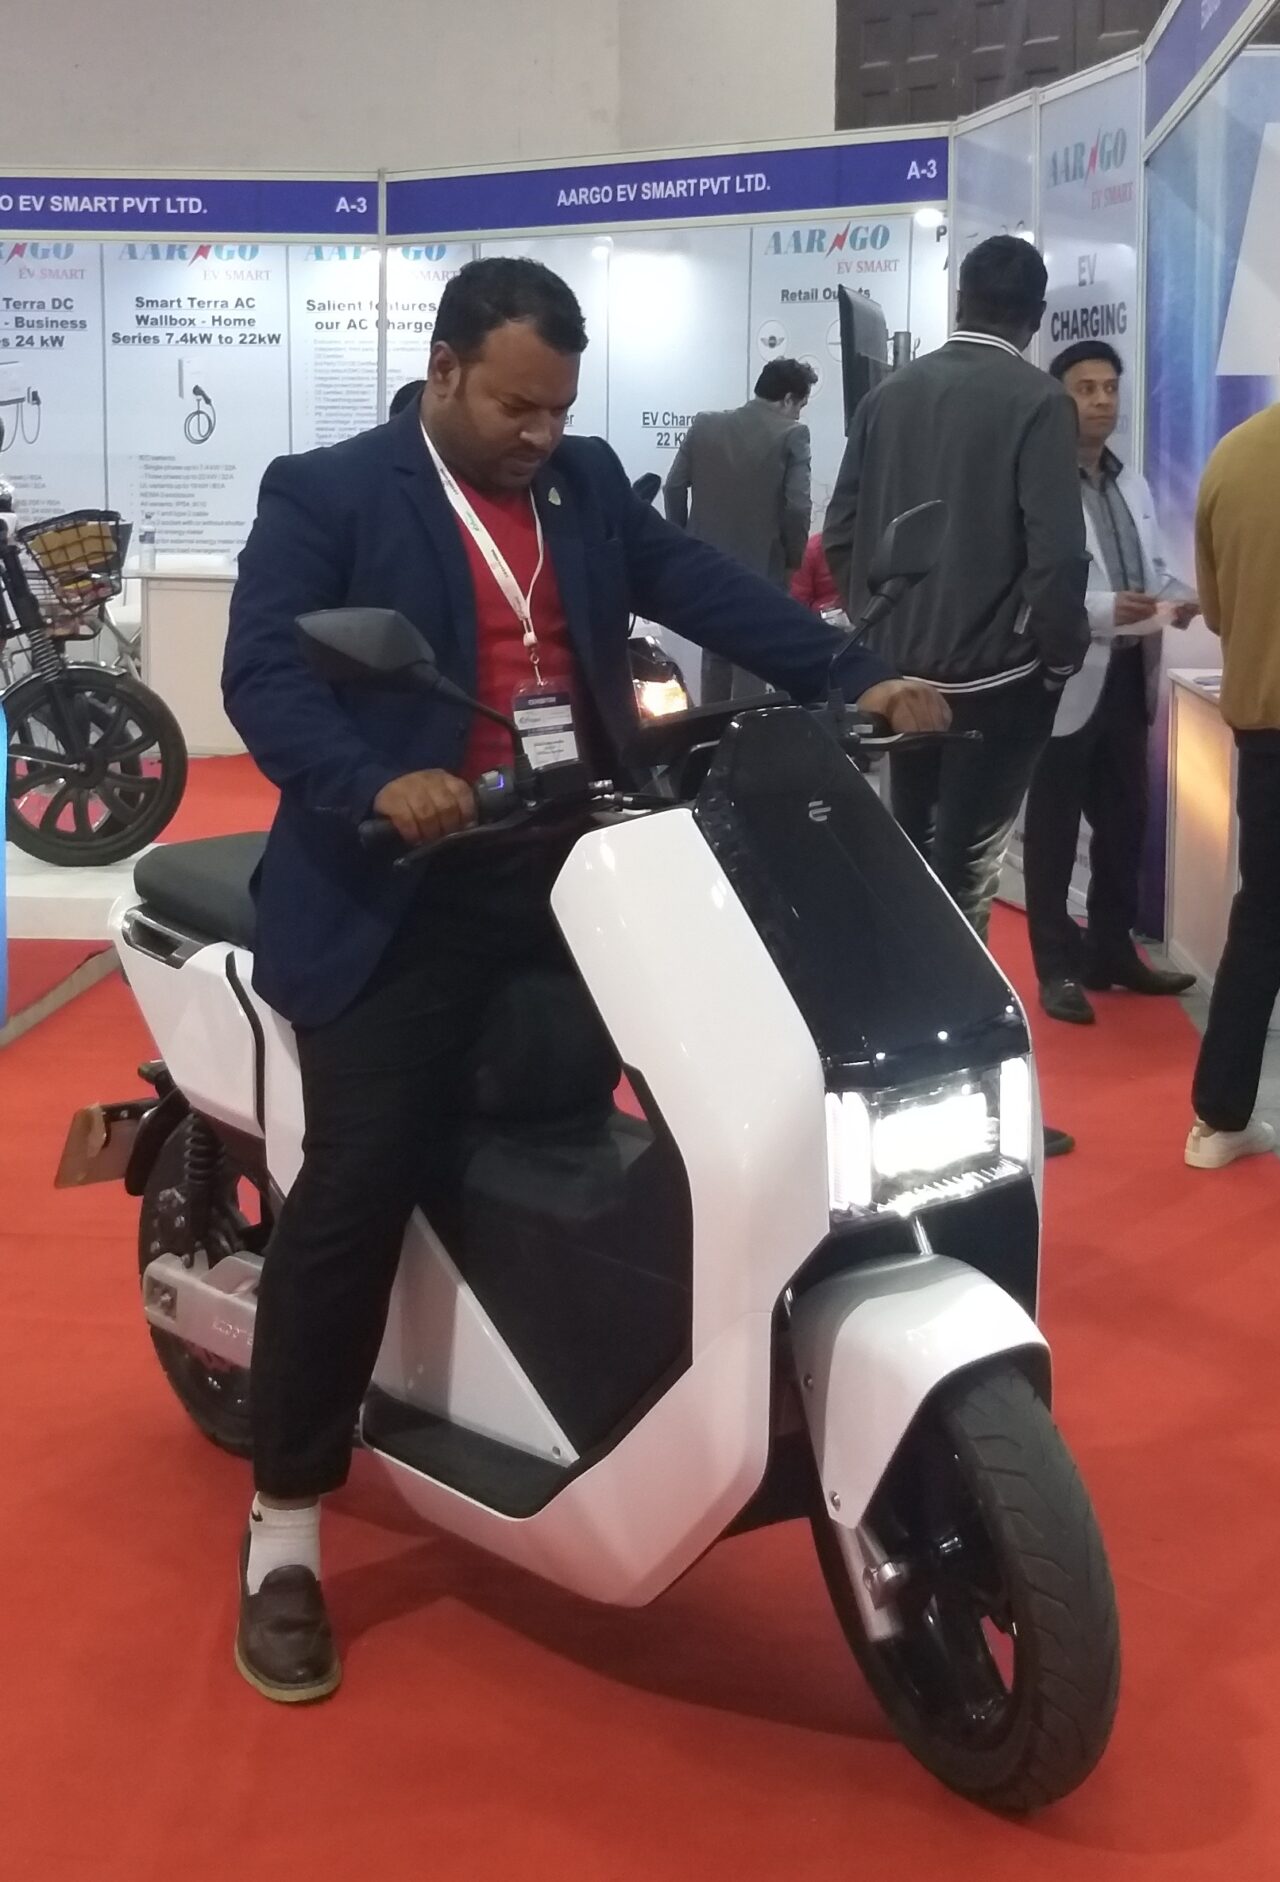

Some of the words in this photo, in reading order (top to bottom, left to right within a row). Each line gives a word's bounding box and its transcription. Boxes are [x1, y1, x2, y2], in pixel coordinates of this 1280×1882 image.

[907, 160, 938, 180] A-3
[557, 185, 613, 206] AARGO
[616, 183, 638, 202] EV
[641, 179, 697, 200] SMART
[699, 176, 731, 196] PVT
[735, 173, 771, 193] LTD.
[19, 195, 45, 211] EV
[50, 196, 119, 212] SMART
[123, 198, 161, 213] PVT
[166, 198, 208, 214] LTD.
[335, 197, 368, 213] A-3
[837, 261, 854, 275] EV
[856, 259, 900, 274] SMART
[1078, 252, 1098, 287] EV
[18, 269, 35, 280] EV
[39, 269, 87, 280] SMART
[225, 270, 272, 281] SMART
[781, 287, 818, 301] Retail
[822, 286, 871, 301] Outs
[2, 298, 46, 310] Terra
[51, 298, 74, 310] DC
[135, 296, 182, 309] Smart
[187, 297, 229, 309] Terra
[234, 297, 256, 309] AC
[306, 299, 362, 312] Salient
[369, 300, 437, 312] ftures
[14, 316, 88, 329] Business
[135, 314, 196, 327] Wallbox
[211, 315, 256, 327] Home
[315, 320, 341, 331] our
[347, 318, 368, 331] AC
[1050, 301, 1128, 342] CHARGING
[15, 335, 35, 347] 24
[40, 335, 65, 348] kW
[111, 332, 160, 345] Series
[165, 333, 213, 345] 7.4kW
[218, 334, 234, 345] to
[239, 333, 282, 345] 22kW
[642, 412, 659, 426] EV
[656, 432, 670, 446] 22
